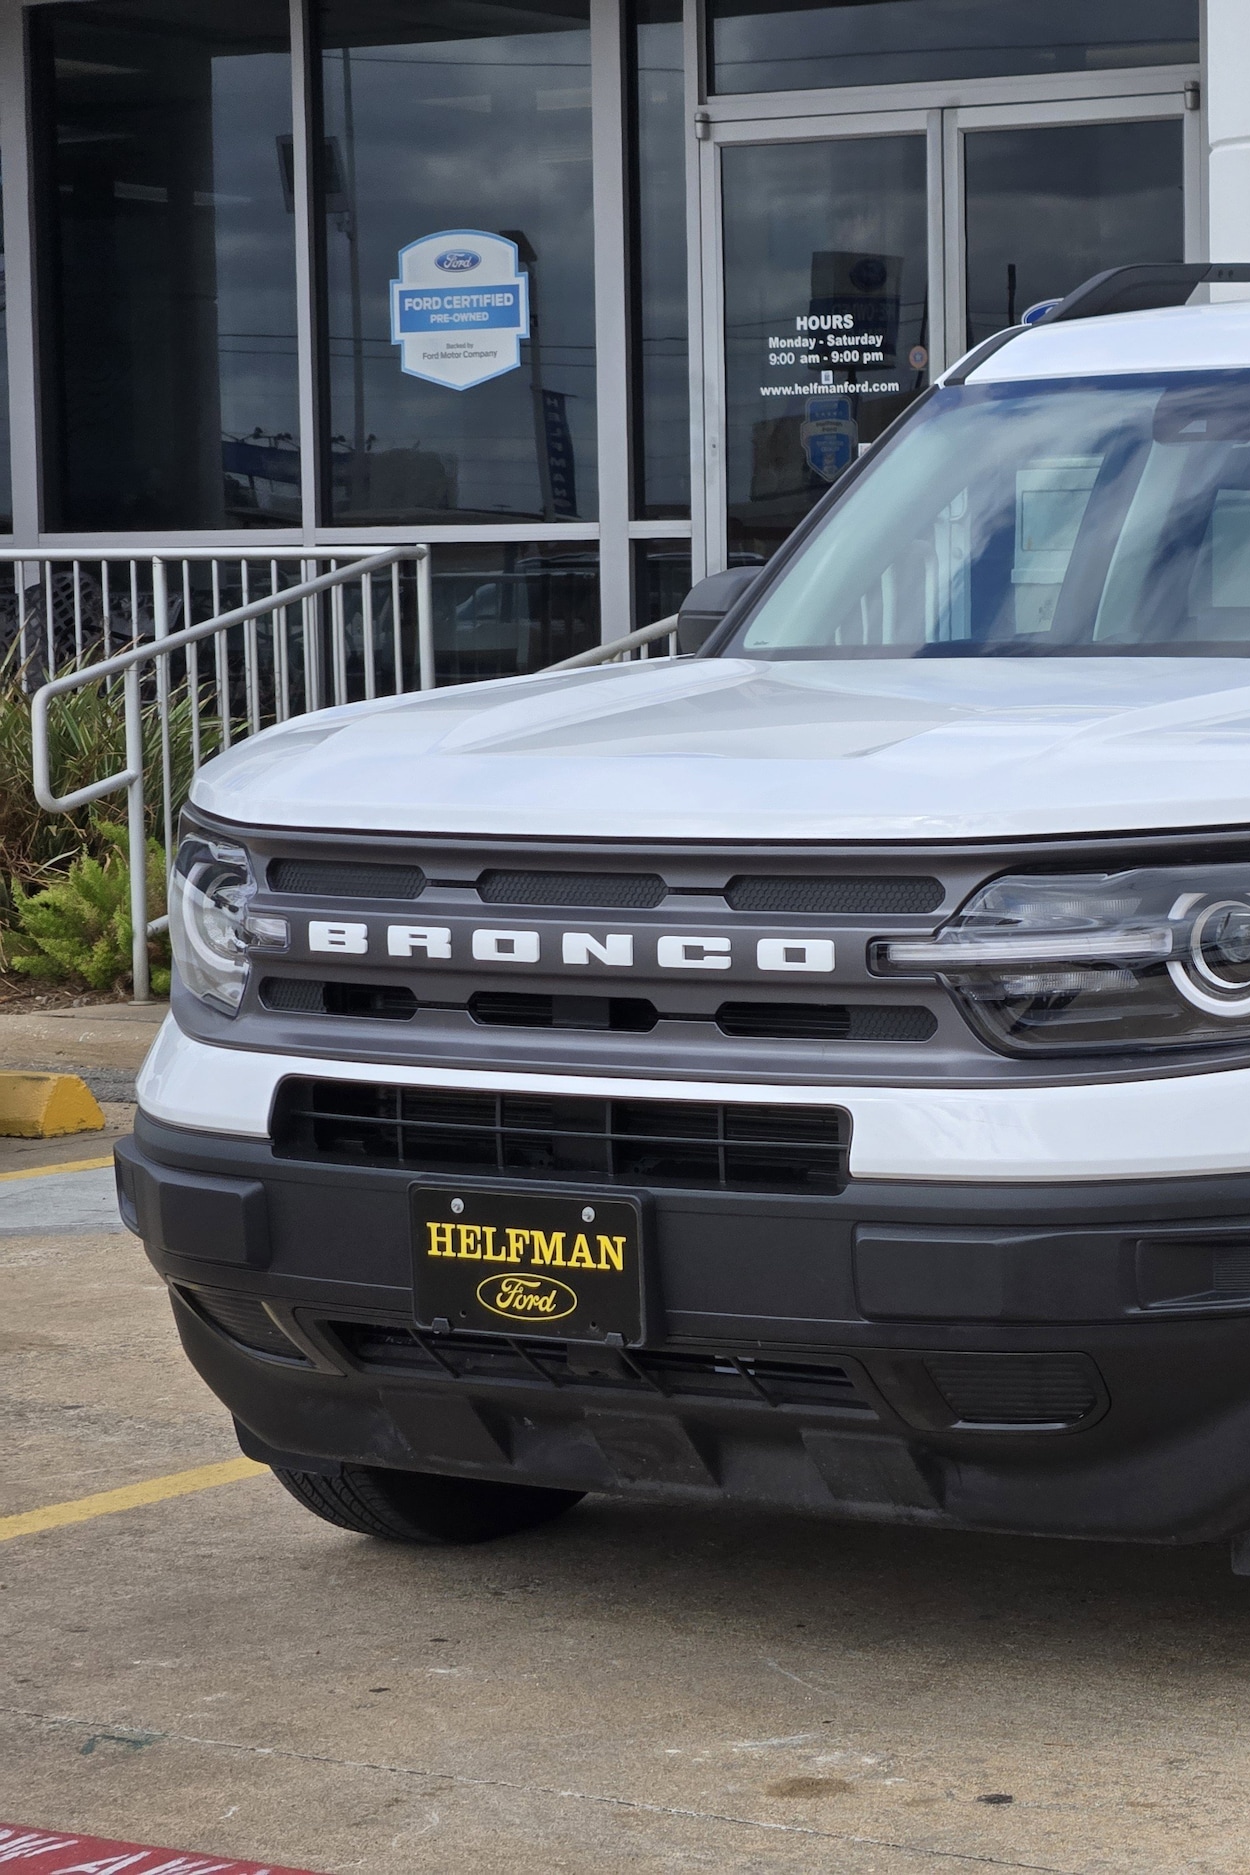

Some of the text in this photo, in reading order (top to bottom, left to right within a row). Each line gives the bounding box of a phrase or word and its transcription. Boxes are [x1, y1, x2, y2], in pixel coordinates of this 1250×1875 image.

[443, 252, 472, 269] Ford
[404, 292, 514, 311] FORD CERTIFIED
[429, 311, 489, 324] PRE-OWNED
[796, 314, 854, 331] HOURS
[466, 342, 474, 351] by
[769, 337, 816, 350] Monday
[826, 333, 883, 347] Saturday
[422, 350, 498, 360] Ford Motor Company
[769, 352, 795, 366] 9:00
[800, 354, 820, 364] am
[831, 350, 860, 363] 9:00
[863, 351, 884, 364] pm
[760, 381, 900, 396] www.helfmanford.com
[308, 920, 836, 972] BRONCO
[426, 1222, 627, 1271] HELFMAN
[496, 1278, 558, 1313] Ford
